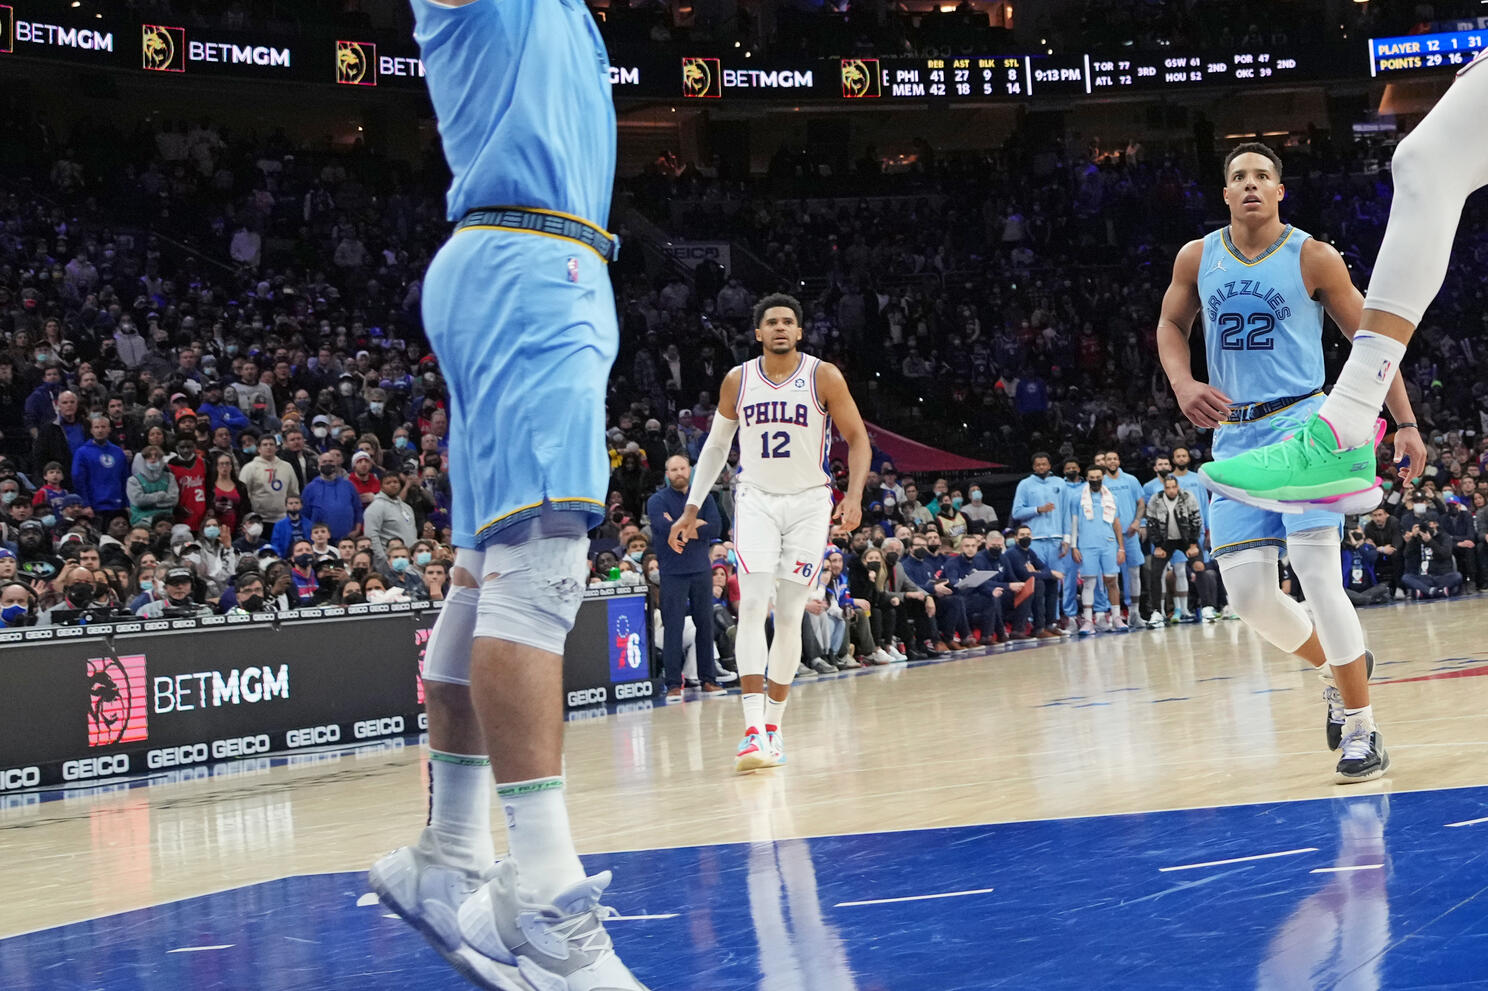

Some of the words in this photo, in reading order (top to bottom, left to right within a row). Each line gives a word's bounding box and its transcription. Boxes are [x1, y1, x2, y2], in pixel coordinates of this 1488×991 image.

[15, 20, 113, 52] BETMGM
[1378, 42, 1420, 56] PLAYER
[1426, 40, 1440, 52] 12
[1451, 38, 1458, 49] 1
[1468, 36, 1482, 48] 31
[189, 41, 291, 68] BETMGM
[1234, 54, 1253, 65] POR
[1258, 54, 1270, 63] 47
[1380, 57, 1422, 70] POINTS
[1426, 54, 1442, 67] 29
[1448, 53, 1462, 64] 16
[379, 55, 427, 78] BET
[928, 60, 944, 69] REB
[953, 59, 969, 68] AST
[979, 59, 995, 68] BLK
[1004, 58, 1019, 68] STL
[1094, 61, 1114, 72] TOR
[1118, 61, 1130, 70] 77
[1164, 58, 1187, 68] GSW
[1190, 57, 1200, 67] 61
[1207, 63, 1227, 73] 2ND
[1276, 59, 1296, 69] 2ND
[724, 69, 813, 88] BETMGM
[897, 70, 919, 83] PHI
[929, 70, 944, 82] 41
[954, 70, 969, 82] 27
[983, 69, 992, 81] 9
[1008, 69, 1017, 80] 8
[1035, 69, 1059, 82] 9:13
[1061, 68, 1081, 81] PM
[1137, 67, 1157, 77] 3RD
[1165, 73, 1187, 83] HOU
[1190, 71, 1202, 81] 52
[1235, 69, 1254, 79] OKC
[1260, 68, 1272, 77] 39
[1095, 76, 1113, 86] ATL
[1119, 75, 1132, 85] 72
[892, 83, 925, 96] MEM
[929, 84, 946, 96] 42
[956, 84, 971, 95] 18
[983, 83, 992, 95] 5
[1006, 83, 1021, 95] 14
[1207, 279, 1292, 322] GRIZZLIES
[1218, 312, 1275, 351] 22
[743, 401, 808, 428] PHILA
[761, 431, 791, 458] 12
[792, 560, 814, 578] 76
[154, 663, 289, 715] BETMGM
[63, 754, 130, 780] GEICO
[147, 743, 208, 769] GEICO
[212, 734, 270, 759] GEICO
[286, 724, 340, 748] GEICO
[354, 716, 405, 738] GEICO
[568, 687, 607, 707] GEICO
[615, 681, 653, 700] GEICO
